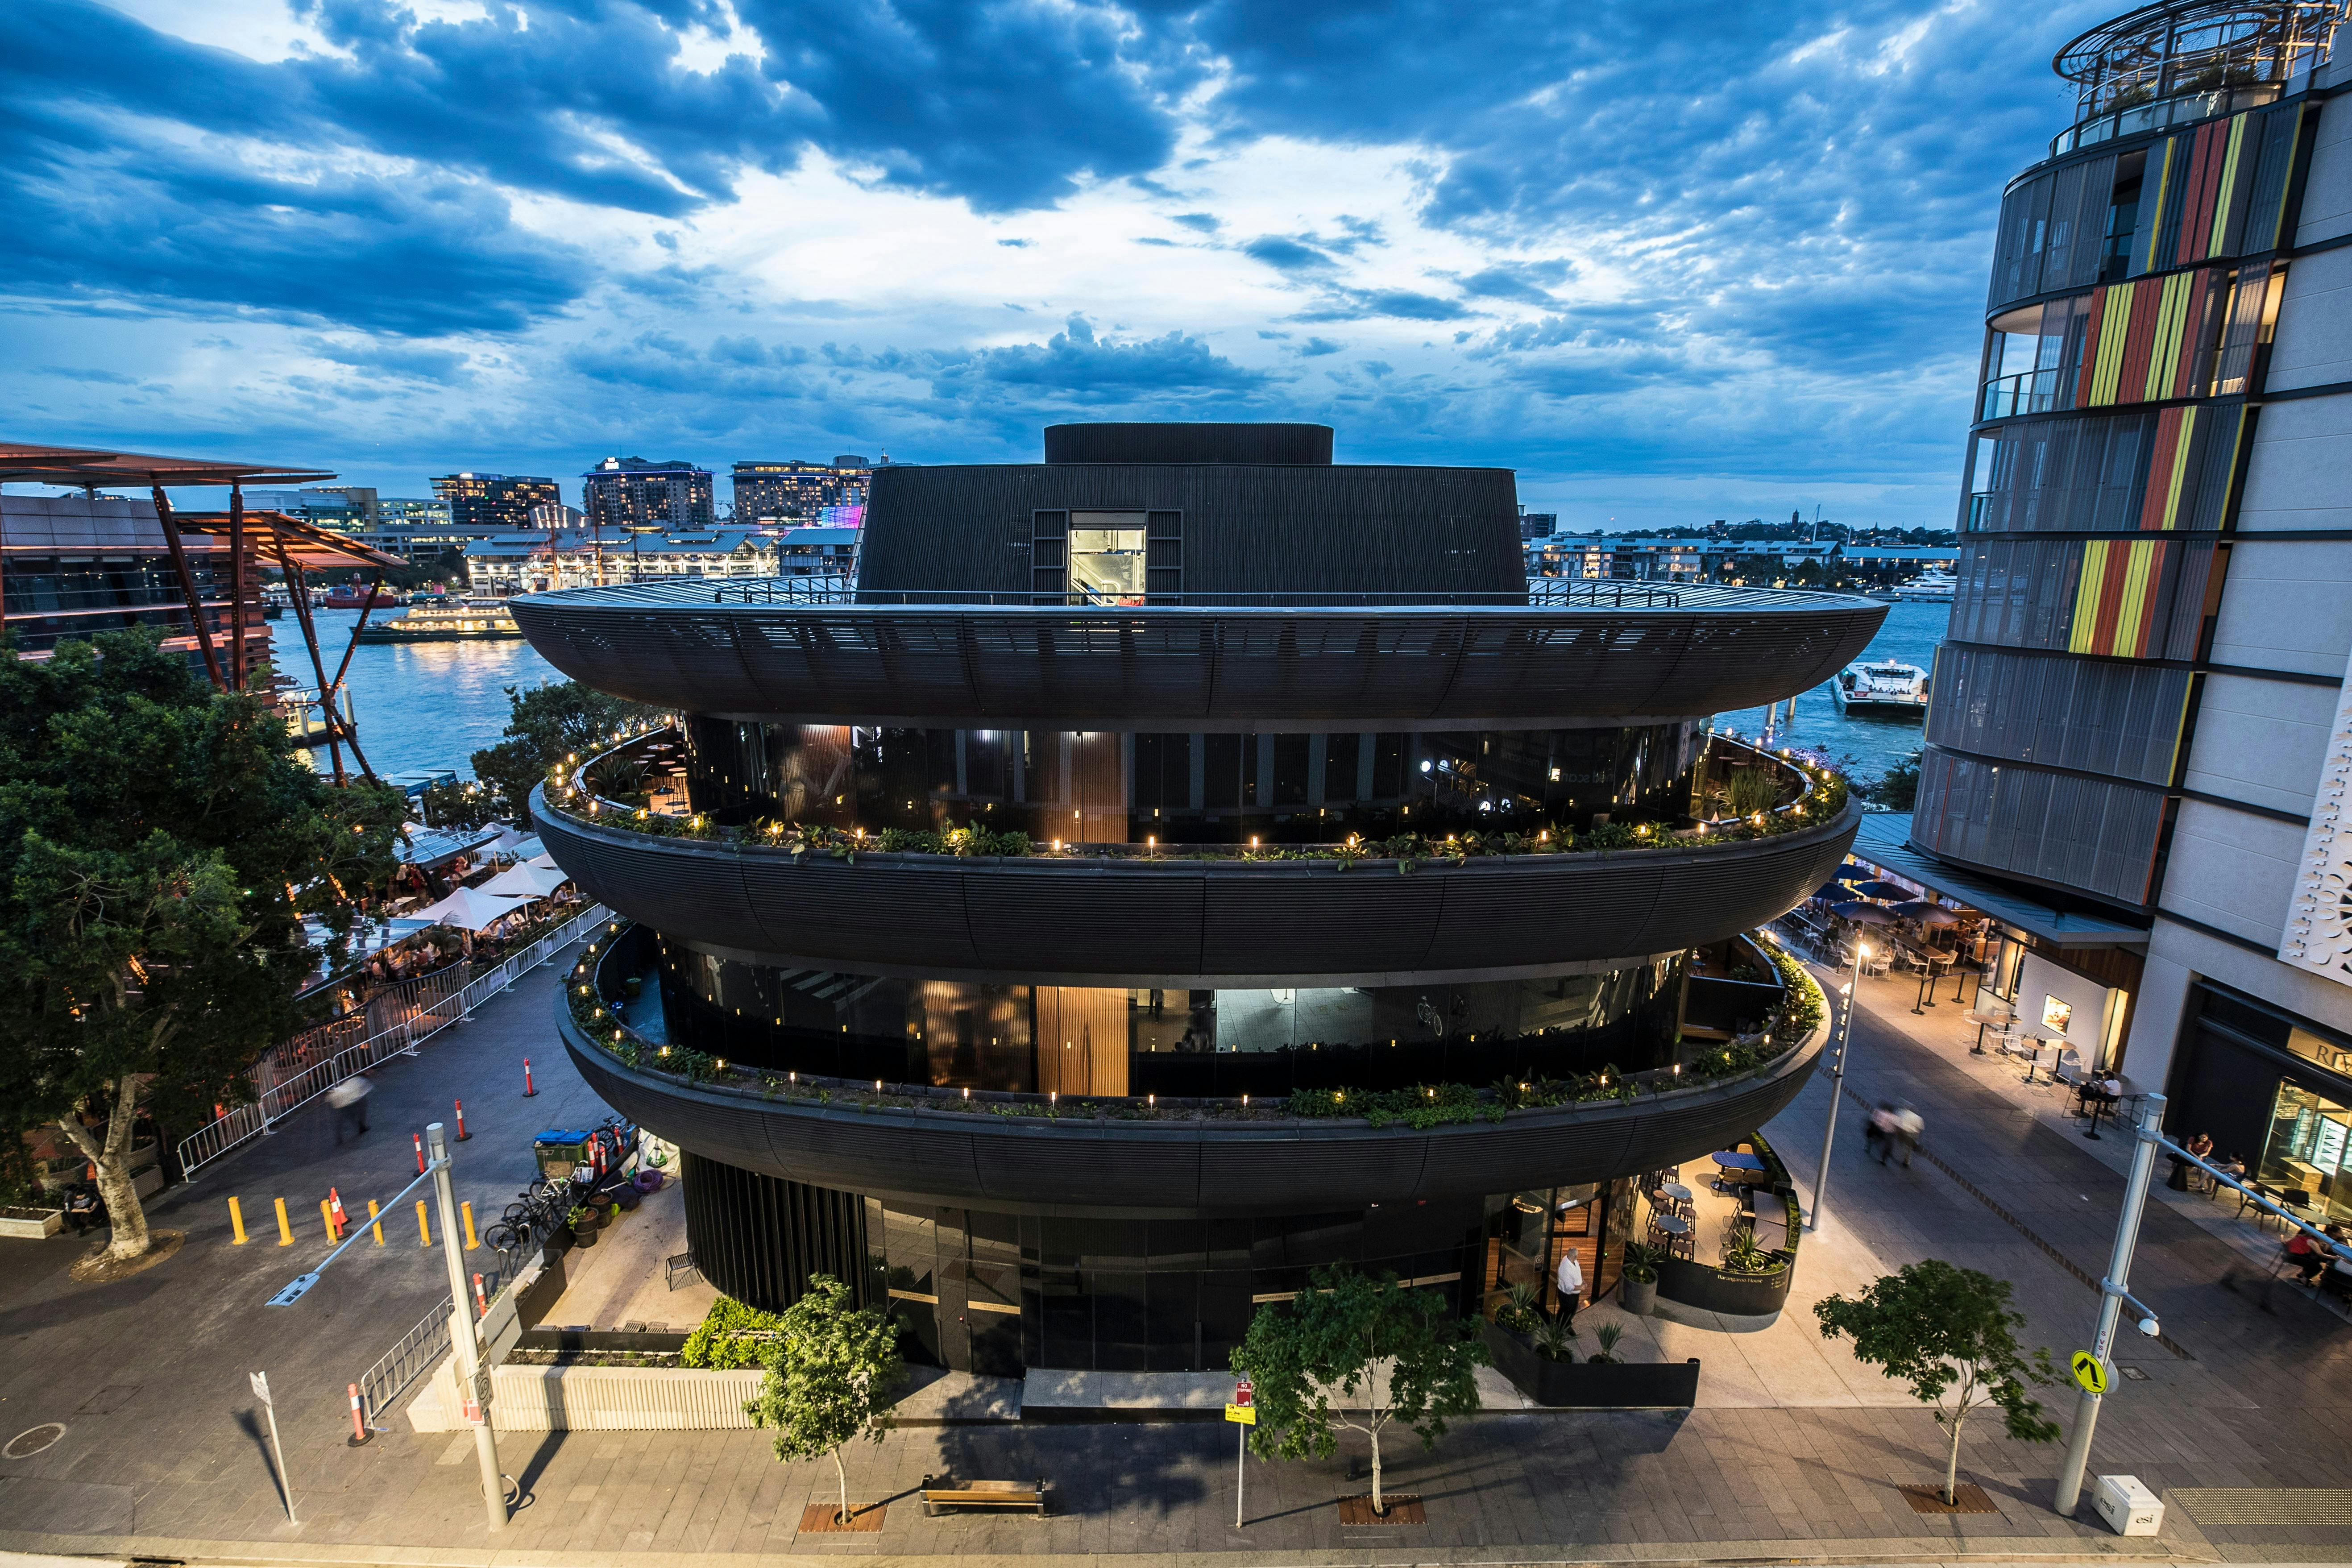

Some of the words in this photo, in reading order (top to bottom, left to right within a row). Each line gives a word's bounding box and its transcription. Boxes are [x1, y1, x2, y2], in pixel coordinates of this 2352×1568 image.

[1717, 1274, 1747, 1282] Barangaroo
[476, 1365, 486, 1383] END
[481, 1381, 487, 1395] 40
[2100, 1497, 2115, 1515] esi
[2136, 1514, 2154, 1524] esi
